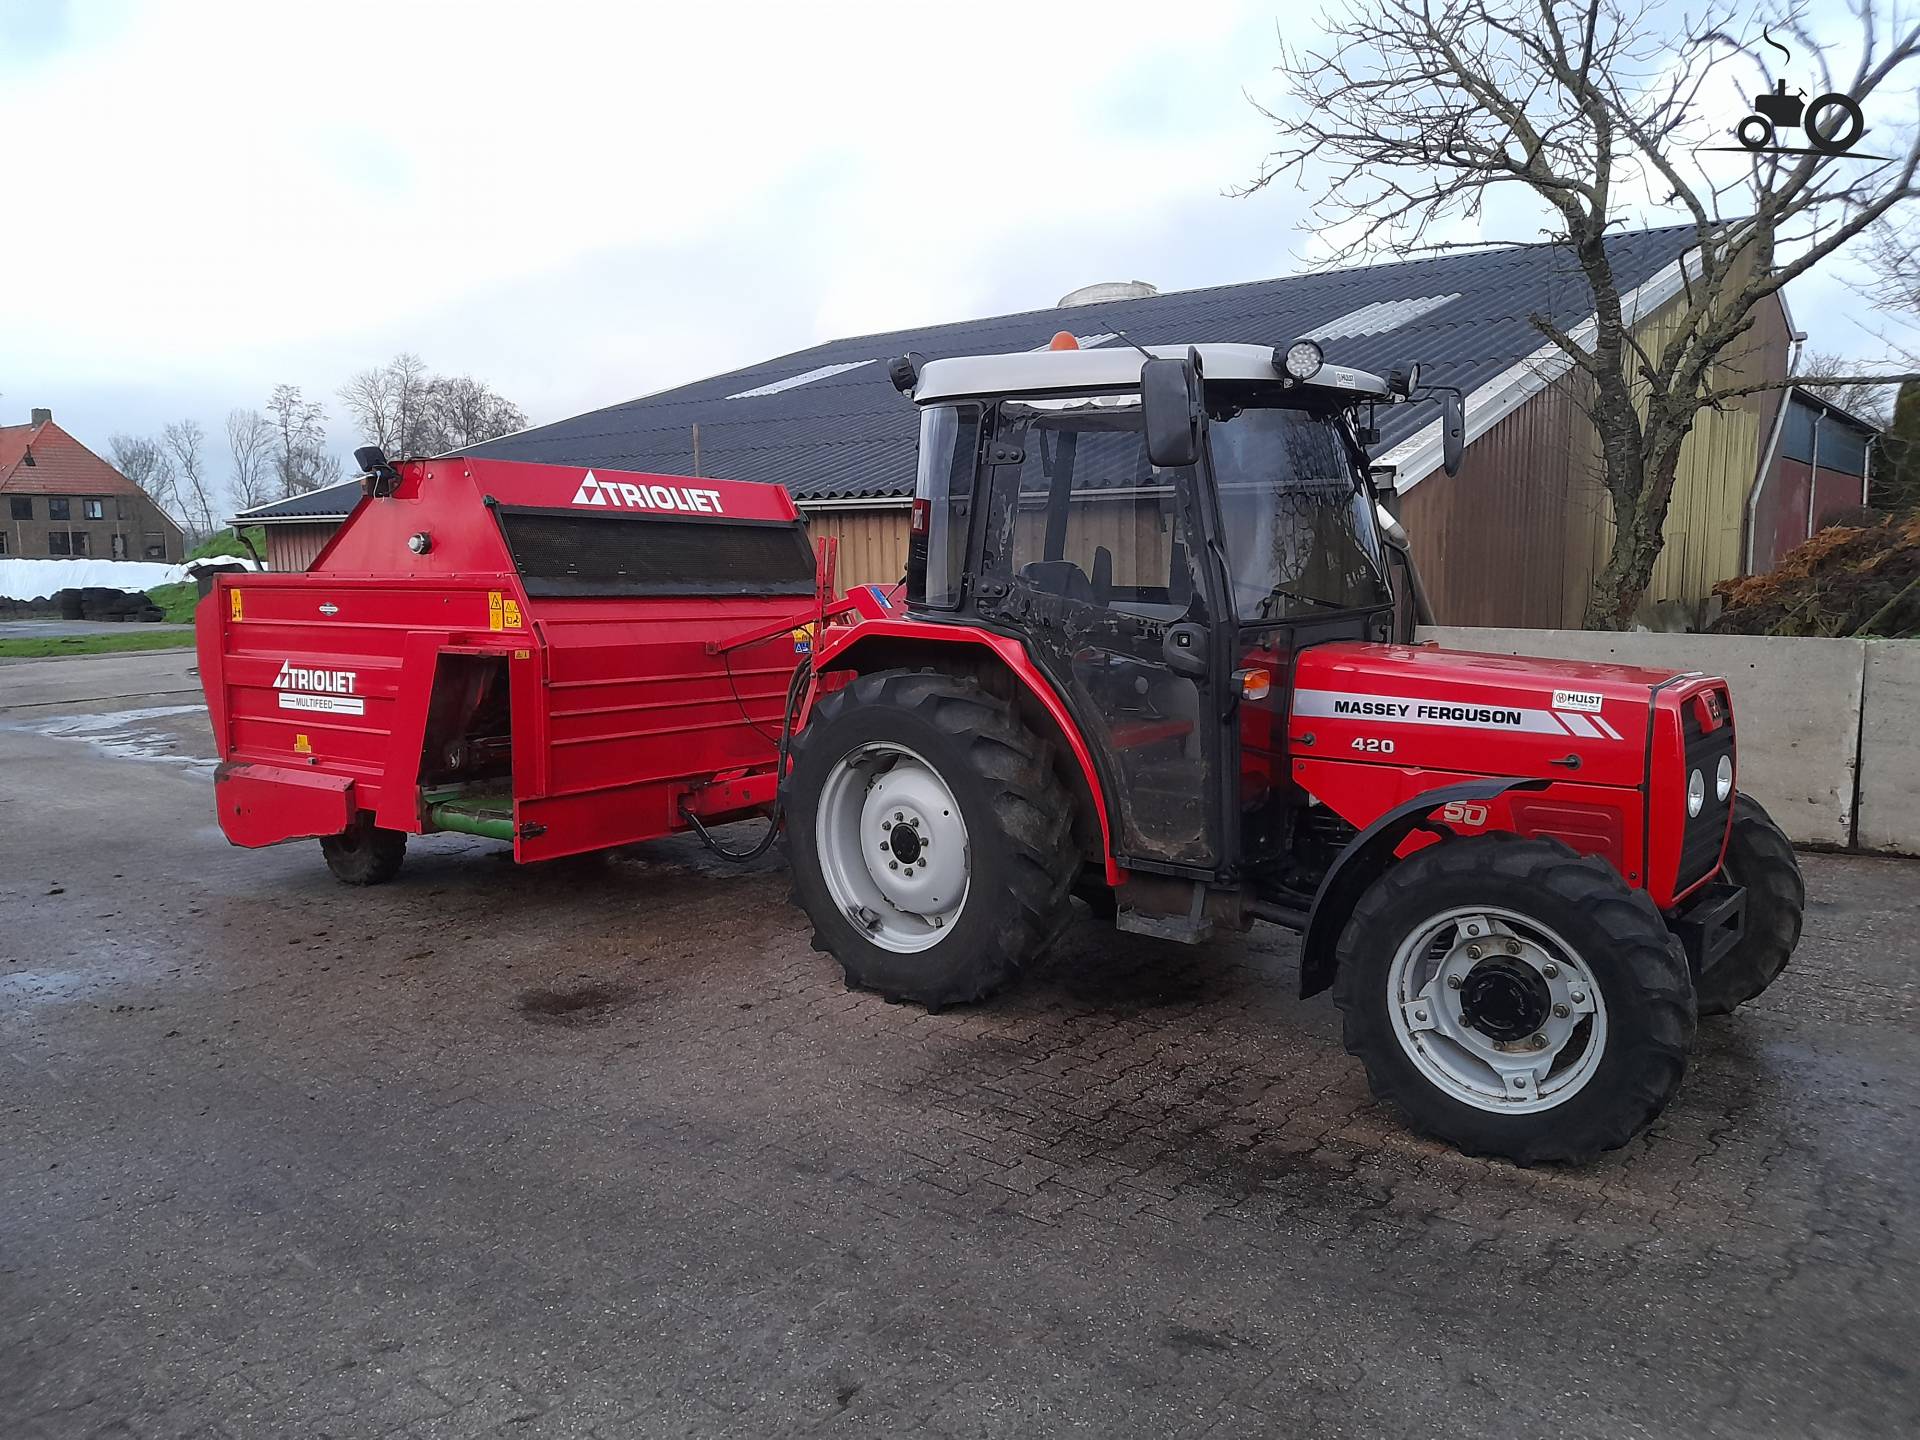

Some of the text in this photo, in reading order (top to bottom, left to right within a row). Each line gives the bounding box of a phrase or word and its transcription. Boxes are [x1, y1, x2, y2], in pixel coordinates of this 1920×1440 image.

[599, 482, 723, 513] TRIOLIET
[289, 669, 356, 693] TRIOLIET
[296, 698, 333, 709] MULTIFEED
[1334, 701, 1521, 725] MASSEY FERGUSON
[1351, 737, 1395, 753] 420
